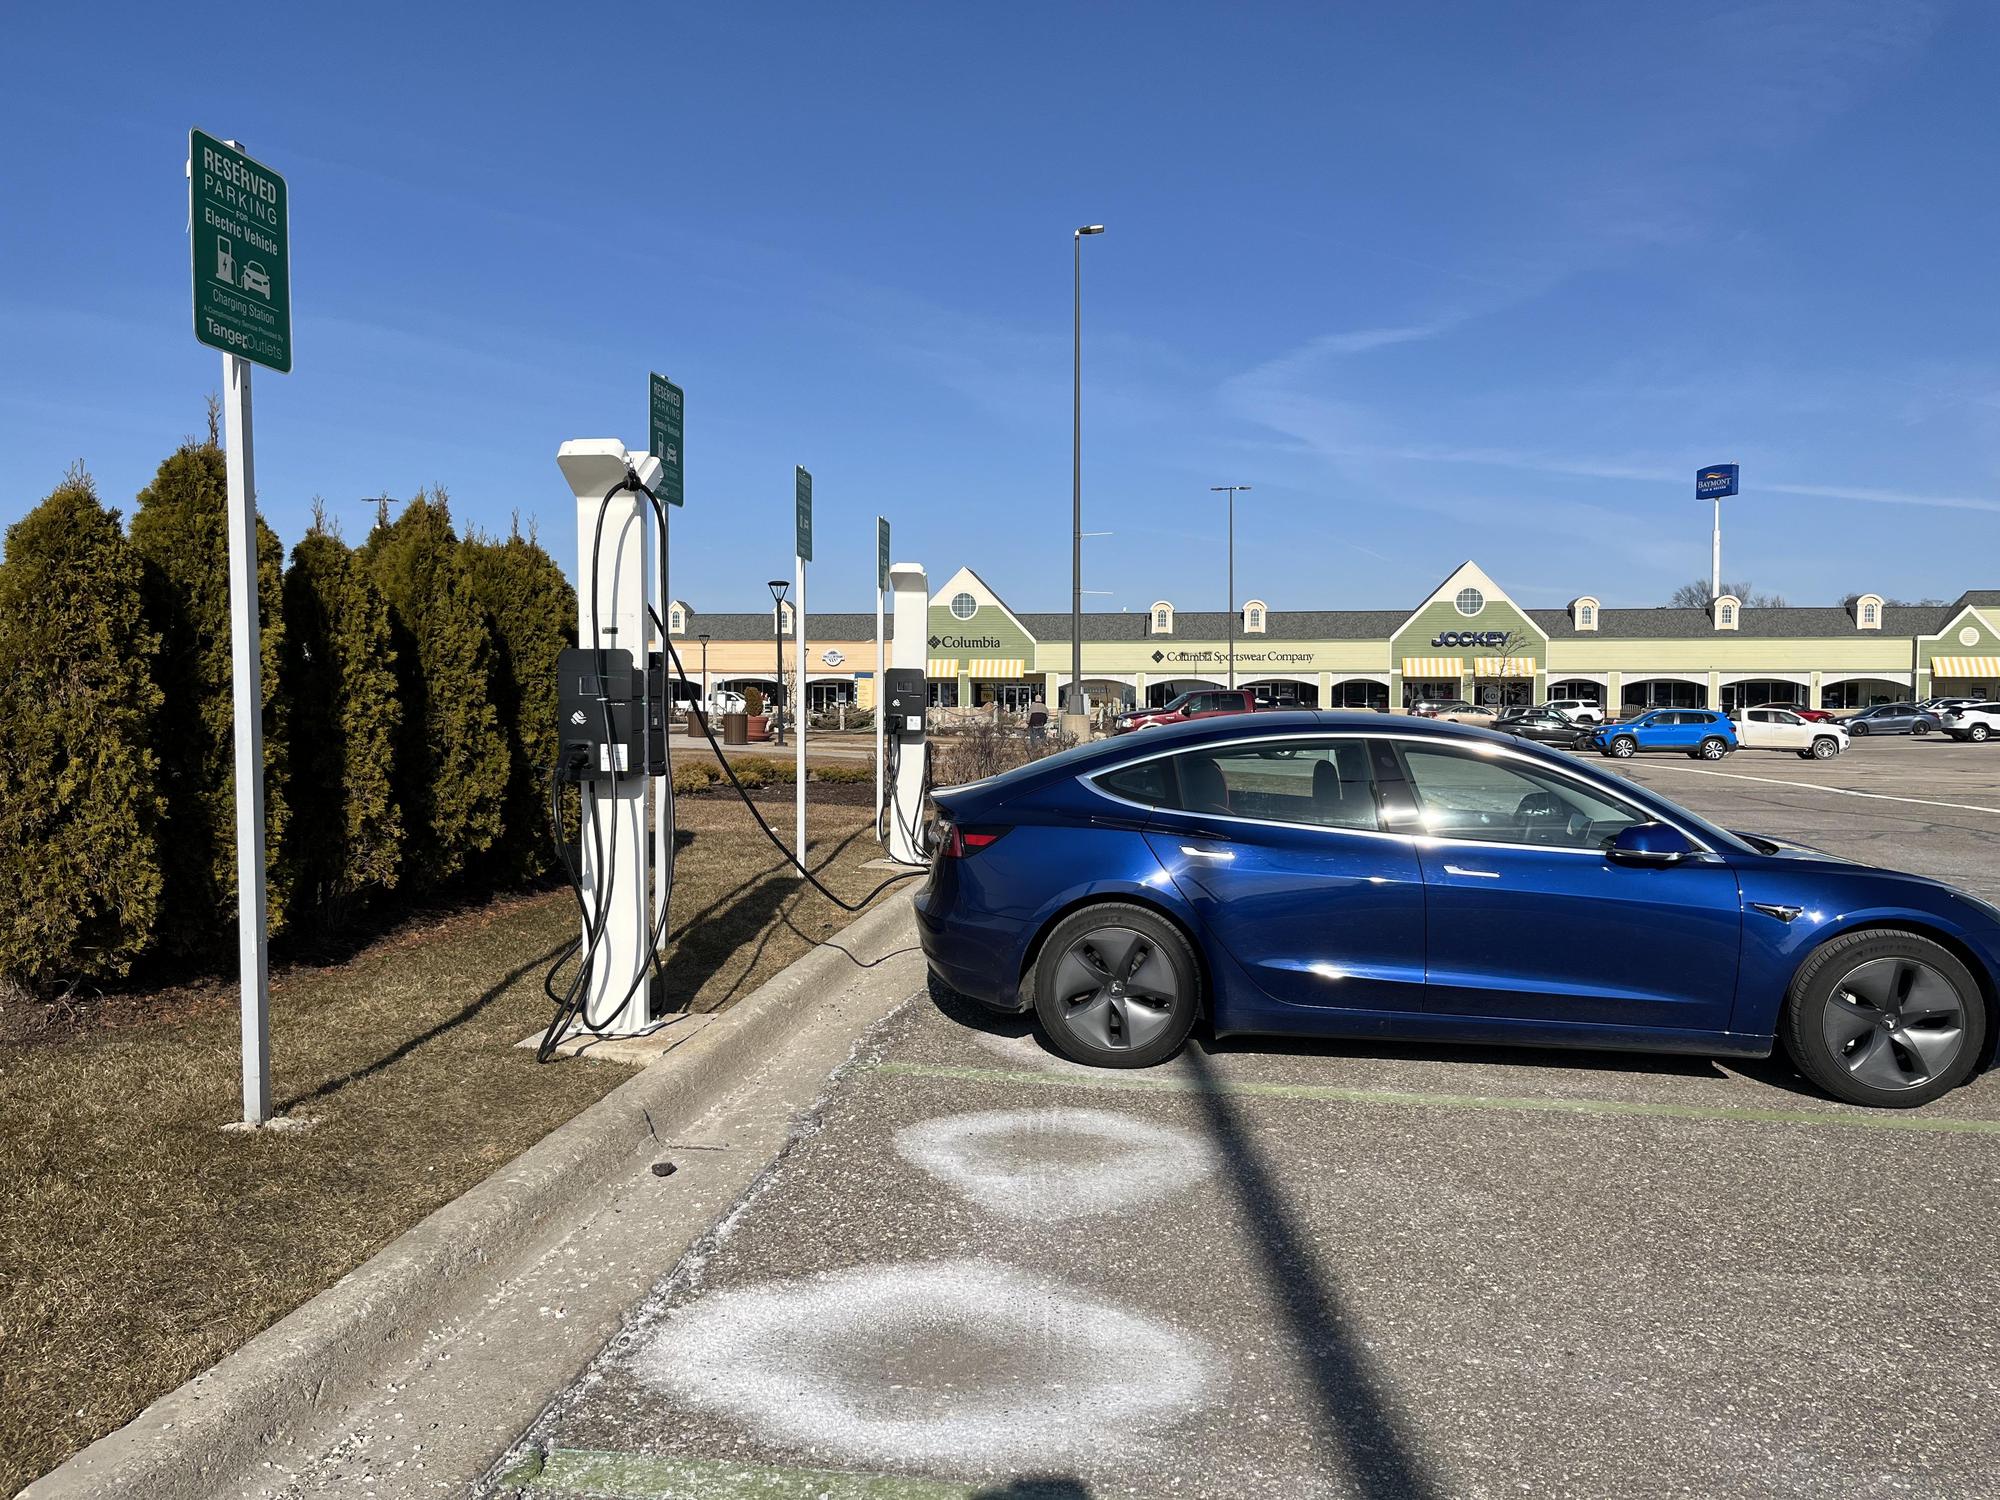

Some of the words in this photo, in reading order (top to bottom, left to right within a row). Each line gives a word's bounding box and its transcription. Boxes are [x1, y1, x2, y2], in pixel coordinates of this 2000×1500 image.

[204, 147, 276, 204] RESERVED
[205, 174, 277, 225] PARKING
[235, 211, 249, 222] FOR
[205, 207, 242, 238] Electric
[244, 226, 278, 256] Vehicle
[213, 288, 248, 316] Charging
[248, 304, 275, 325] Station
[654, 382, 680, 407] RESERVED
[654, 397, 680, 420] PARKING
[1698, 477, 1732, 489] BAYMONT
[942, 635, 1001, 649] Columbia
[1431, 631, 1511, 648] JOCKEY
[1166, 651, 1212, 662] Columbia
[1267, 651, 1315, 664] Company
